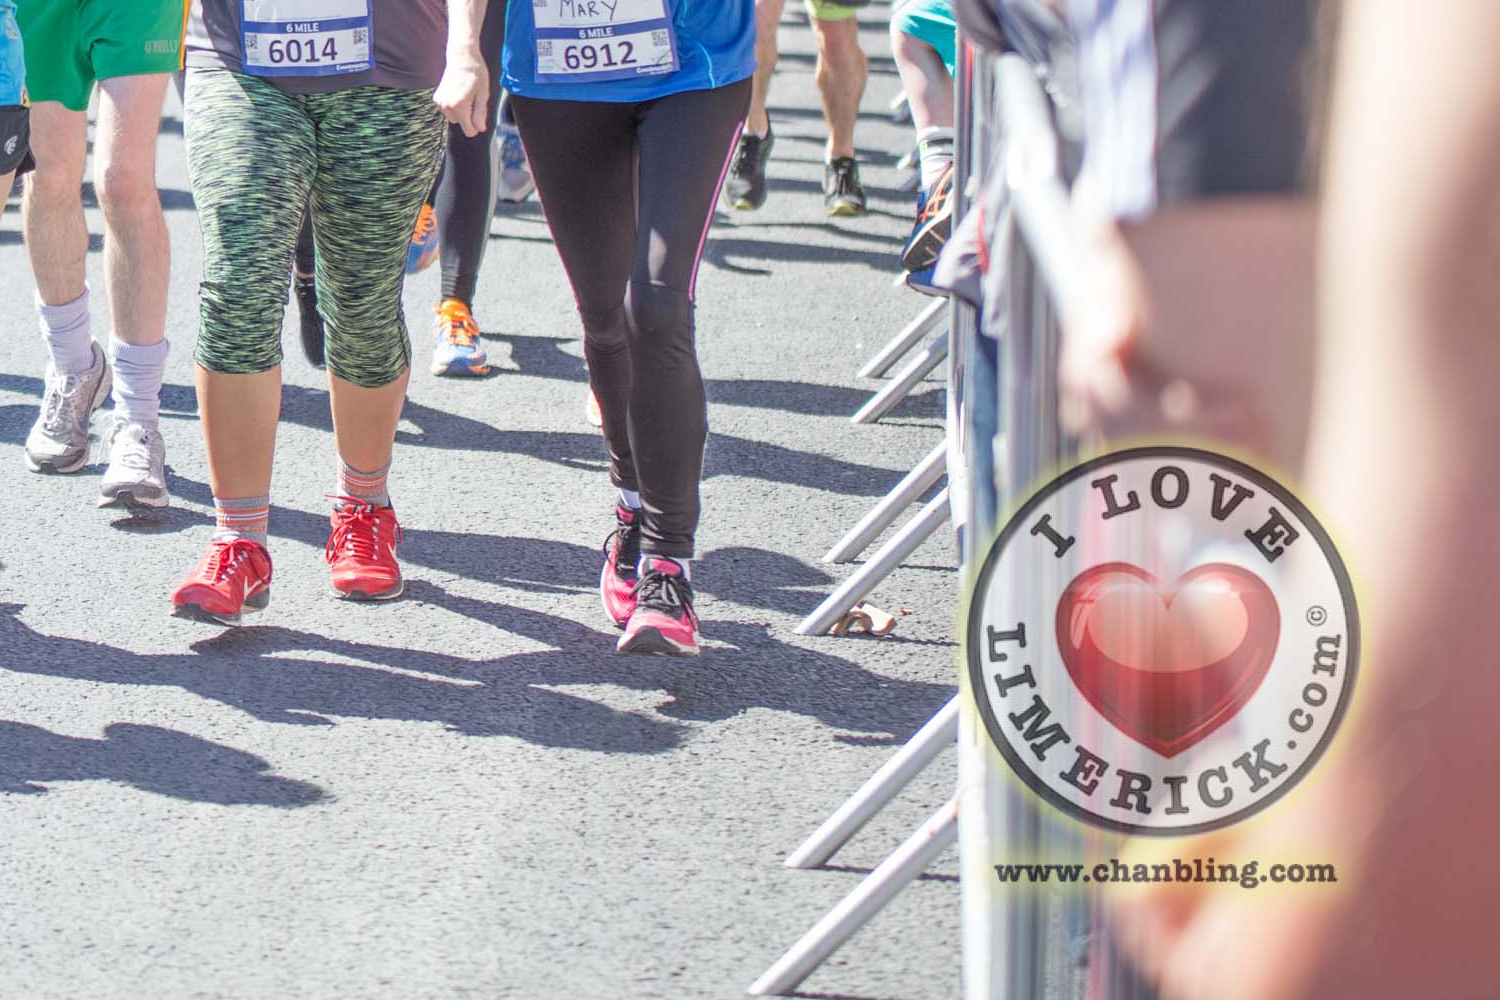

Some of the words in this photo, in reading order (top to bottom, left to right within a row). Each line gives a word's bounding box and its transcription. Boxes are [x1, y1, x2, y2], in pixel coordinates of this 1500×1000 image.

[286, 23, 293, 32] 6
[295, 23, 320, 32] MILE
[579, 29, 587, 39] 6
[588, 27, 613, 39] MILE
[269, 37, 338, 64] 6014
[564, 40, 637, 70] 6912
